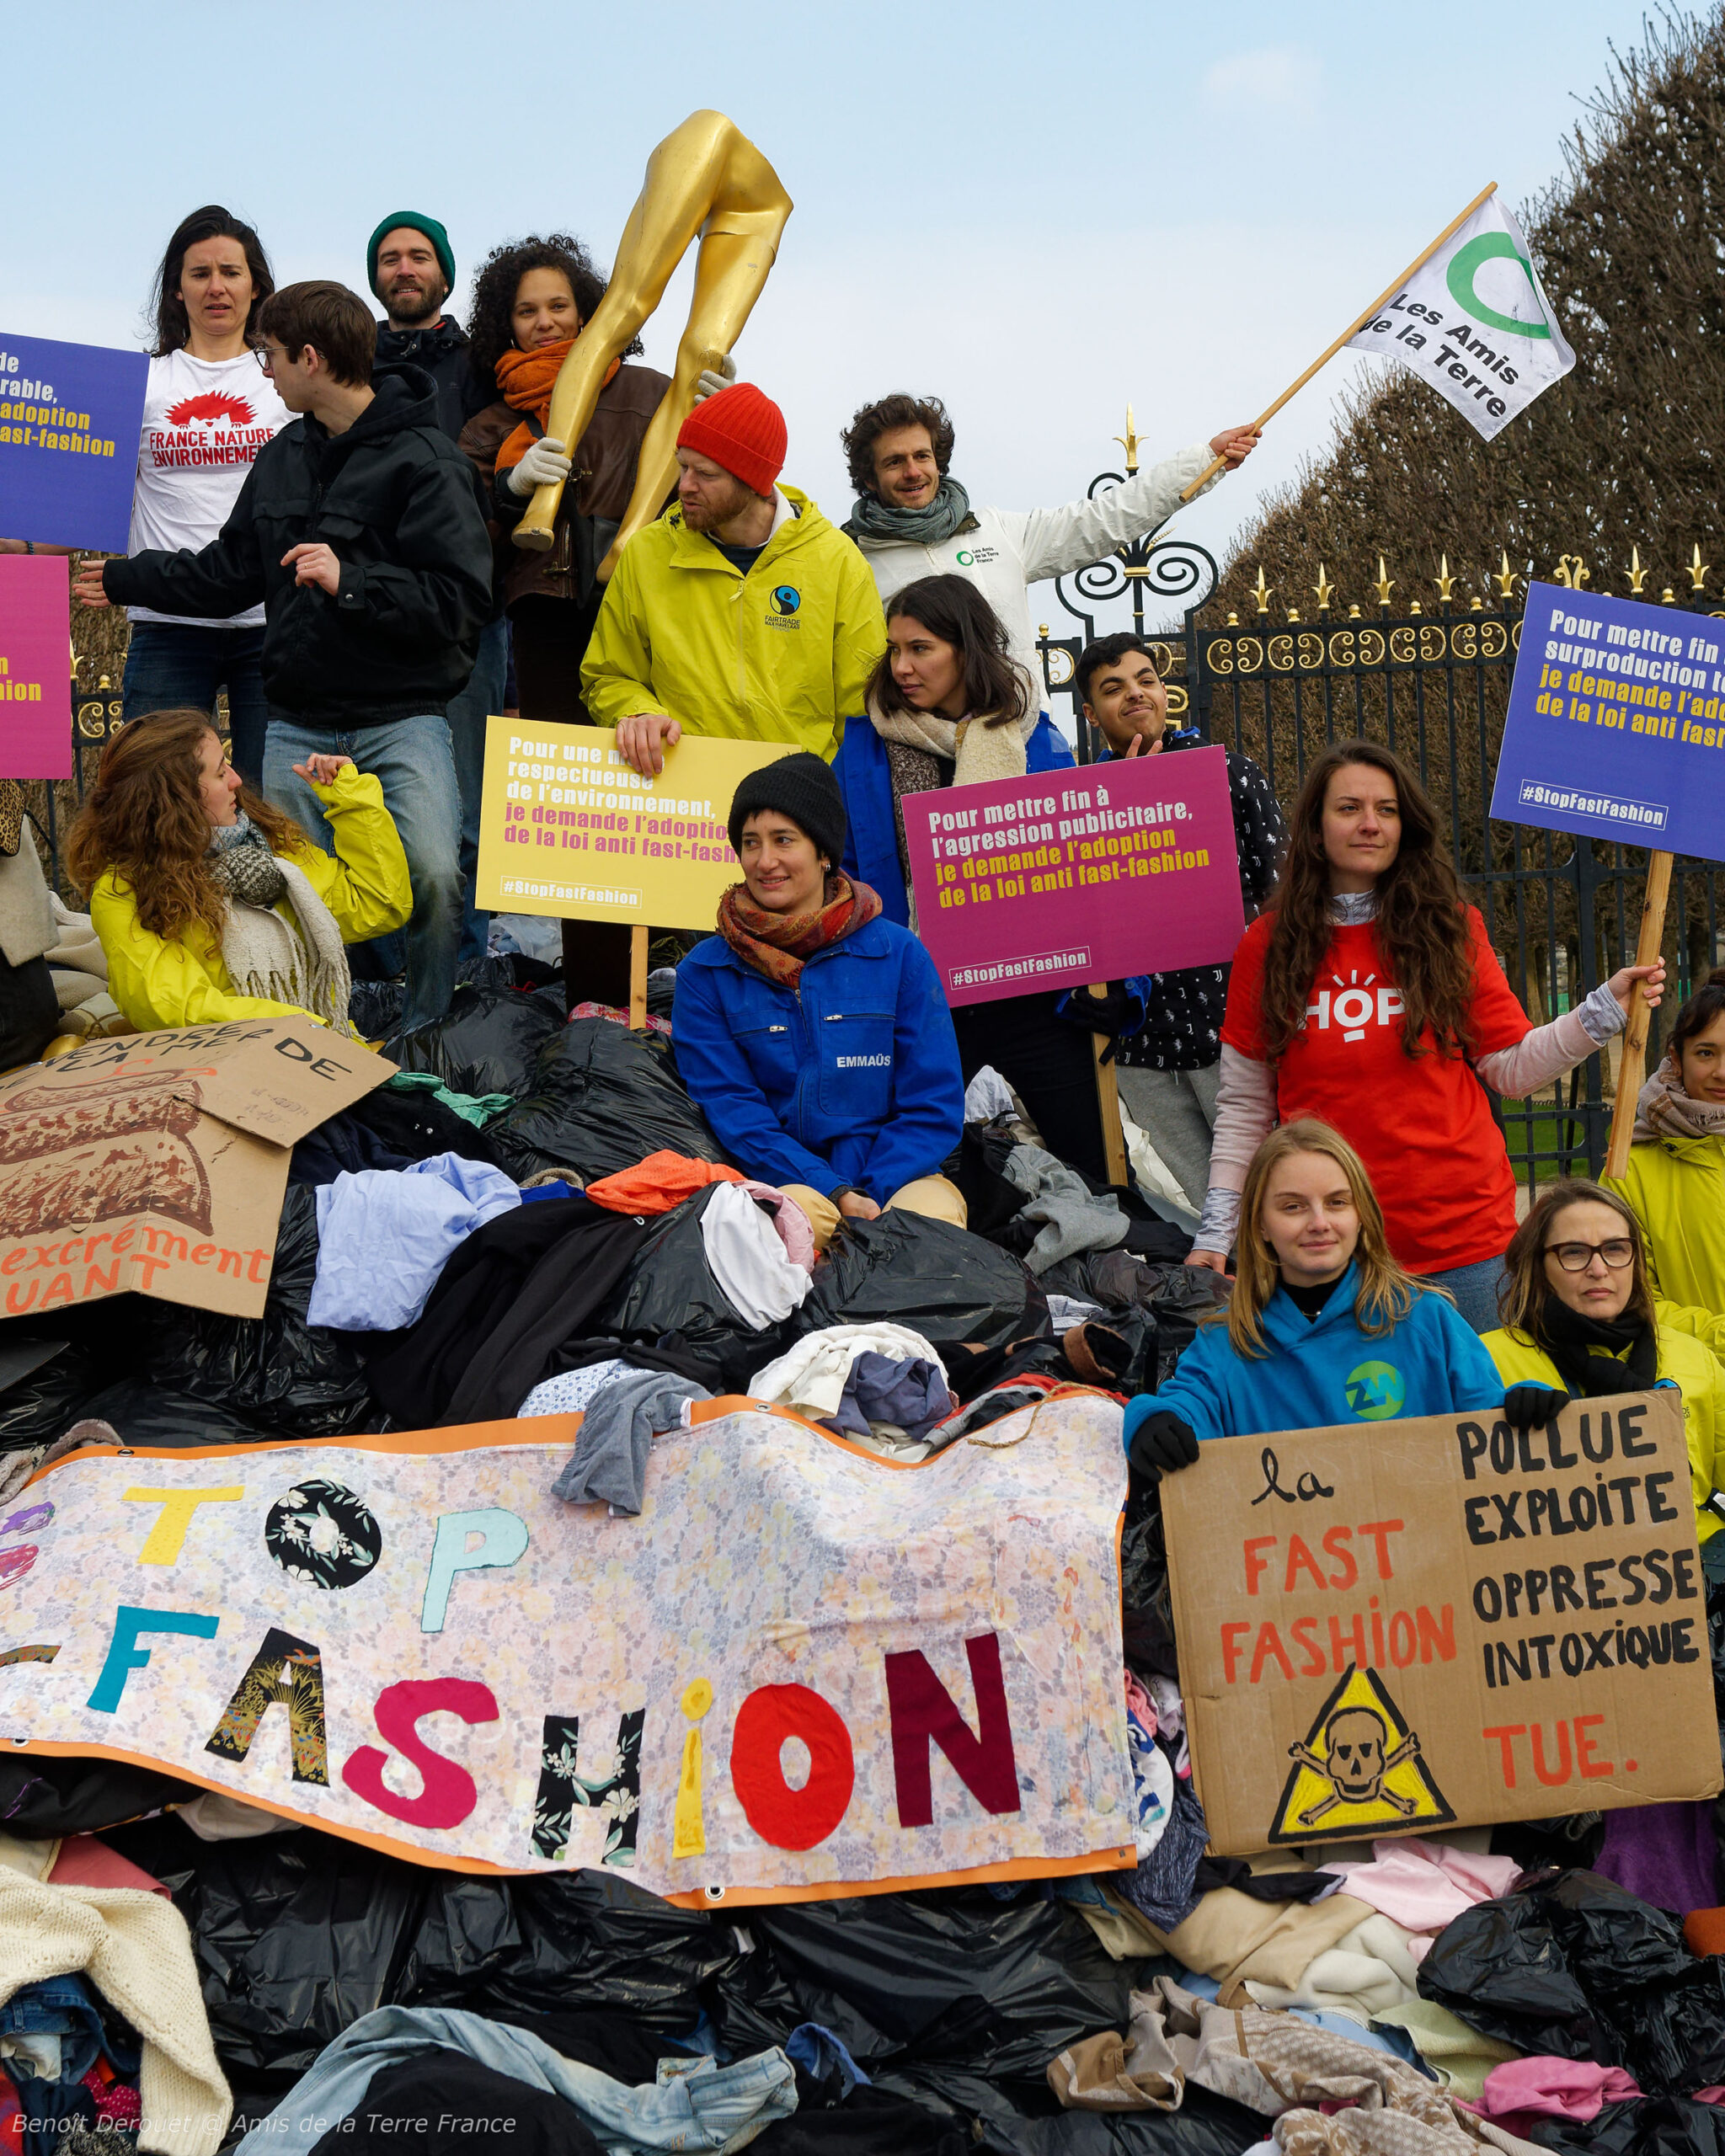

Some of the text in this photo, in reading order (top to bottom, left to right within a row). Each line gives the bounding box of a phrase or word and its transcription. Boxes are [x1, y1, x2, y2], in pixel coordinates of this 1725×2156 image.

[1389, 293, 1519, 385] Les Amis
[0, 378, 57, 404] rable,
[1396, 324, 1427, 350] la
[1434, 344, 1506, 418] Terre
[0, 402, 90, 430] adoption
[150, 428, 275, 450] FRANCE NATURE
[0, 425, 115, 457] ast-fashion
[152, 445, 262, 467] ENVIRONNEME
[765, 616, 800, 625] FAIRTRADE
[1550, 609, 1718, 664] Pour mettre fin
[1539, 664, 1562, 689] je
[1567, 670, 1672, 710] demande
[1545, 640, 1706, 690] surproduction
[1535, 692, 1563, 717] de
[1568, 697, 1590, 723] la
[1596, 703, 1626, 729] loi
[1632, 713, 1676, 739] anti
[510, 736, 558, 759] Pour
[563, 744, 601, 763] une
[508, 760, 654, 790] respectueuse
[505, 803, 728, 841] je demande l'adoptio
[507, 782, 716, 819] de l'environnement,
[928, 785, 1109, 833] Pour mettre fin à
[1523, 786, 1664, 825] #StopFastFashion
[505, 825, 529, 844] de
[537, 827, 555, 846] la
[562, 830, 588, 850] loi
[595, 835, 636, 855] anti
[932, 801, 1193, 858] l'agression publicitaire,
[936, 829, 1176, 885] je demande l'adoption
[939, 848, 1209, 909] de la loi anti fast-fashion
[504, 881, 638, 905] #StopFastFashion
[953, 950, 1087, 985] #StopFastFashion
[1297, 988, 1406, 1030] HOP
[45, 1020, 255, 1067] VENDRE
[56, 1053, 129, 1072] LA
[836, 1054, 890, 1068] EMMAÜS
[1, 1219, 271, 1283] excrément
[5, 1254, 171, 1314] UANT
[1456, 1405, 1657, 1480] POLLUE
[1252, 1448, 1334, 1505] la
[1243, 1519, 1404, 1596] FAST
[1473, 1549, 1699, 1623] OPPRESSE
[1482, 1713, 1638, 1789] TUE.
